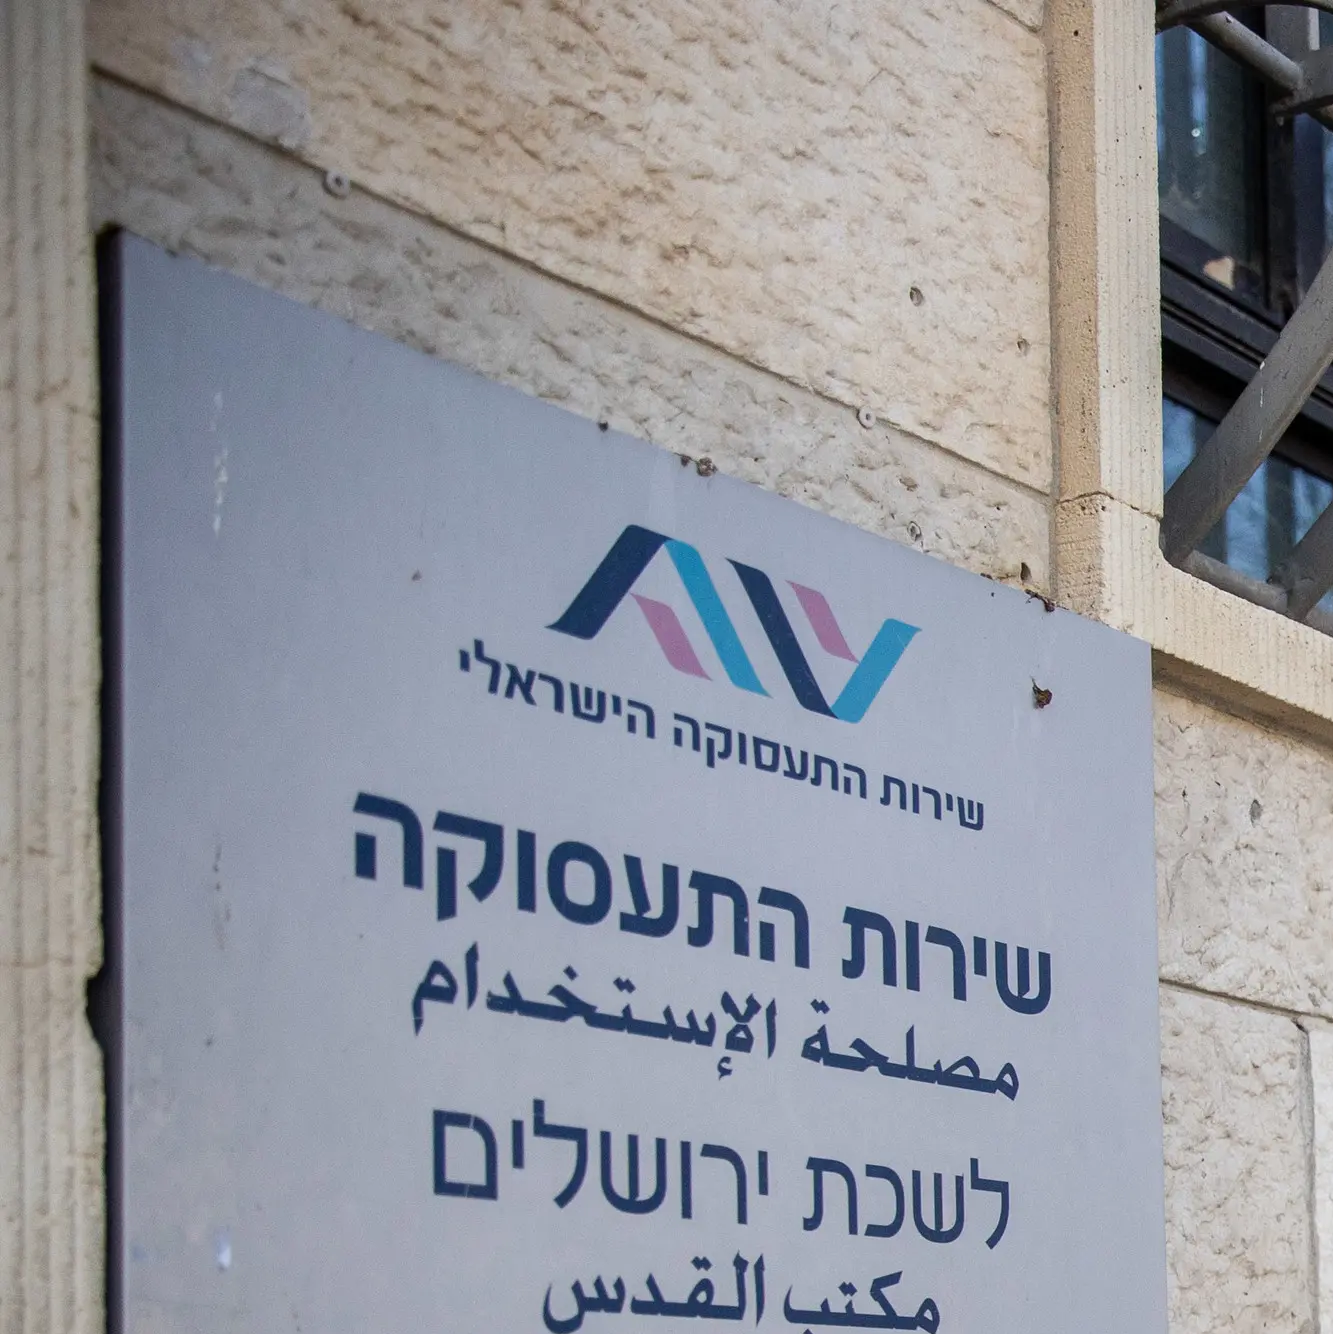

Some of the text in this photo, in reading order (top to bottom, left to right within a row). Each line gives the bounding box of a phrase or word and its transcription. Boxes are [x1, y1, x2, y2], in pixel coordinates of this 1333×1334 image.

[458, 638, 984, 831] שירות התעסוקה הישראלי
[352, 791, 1052, 1015] שירות התעסוקה
[411, 942, 1020, 1101] مصلحة الإستخدام
[432, 1098, 1010, 1250] לשכת ירושלים
